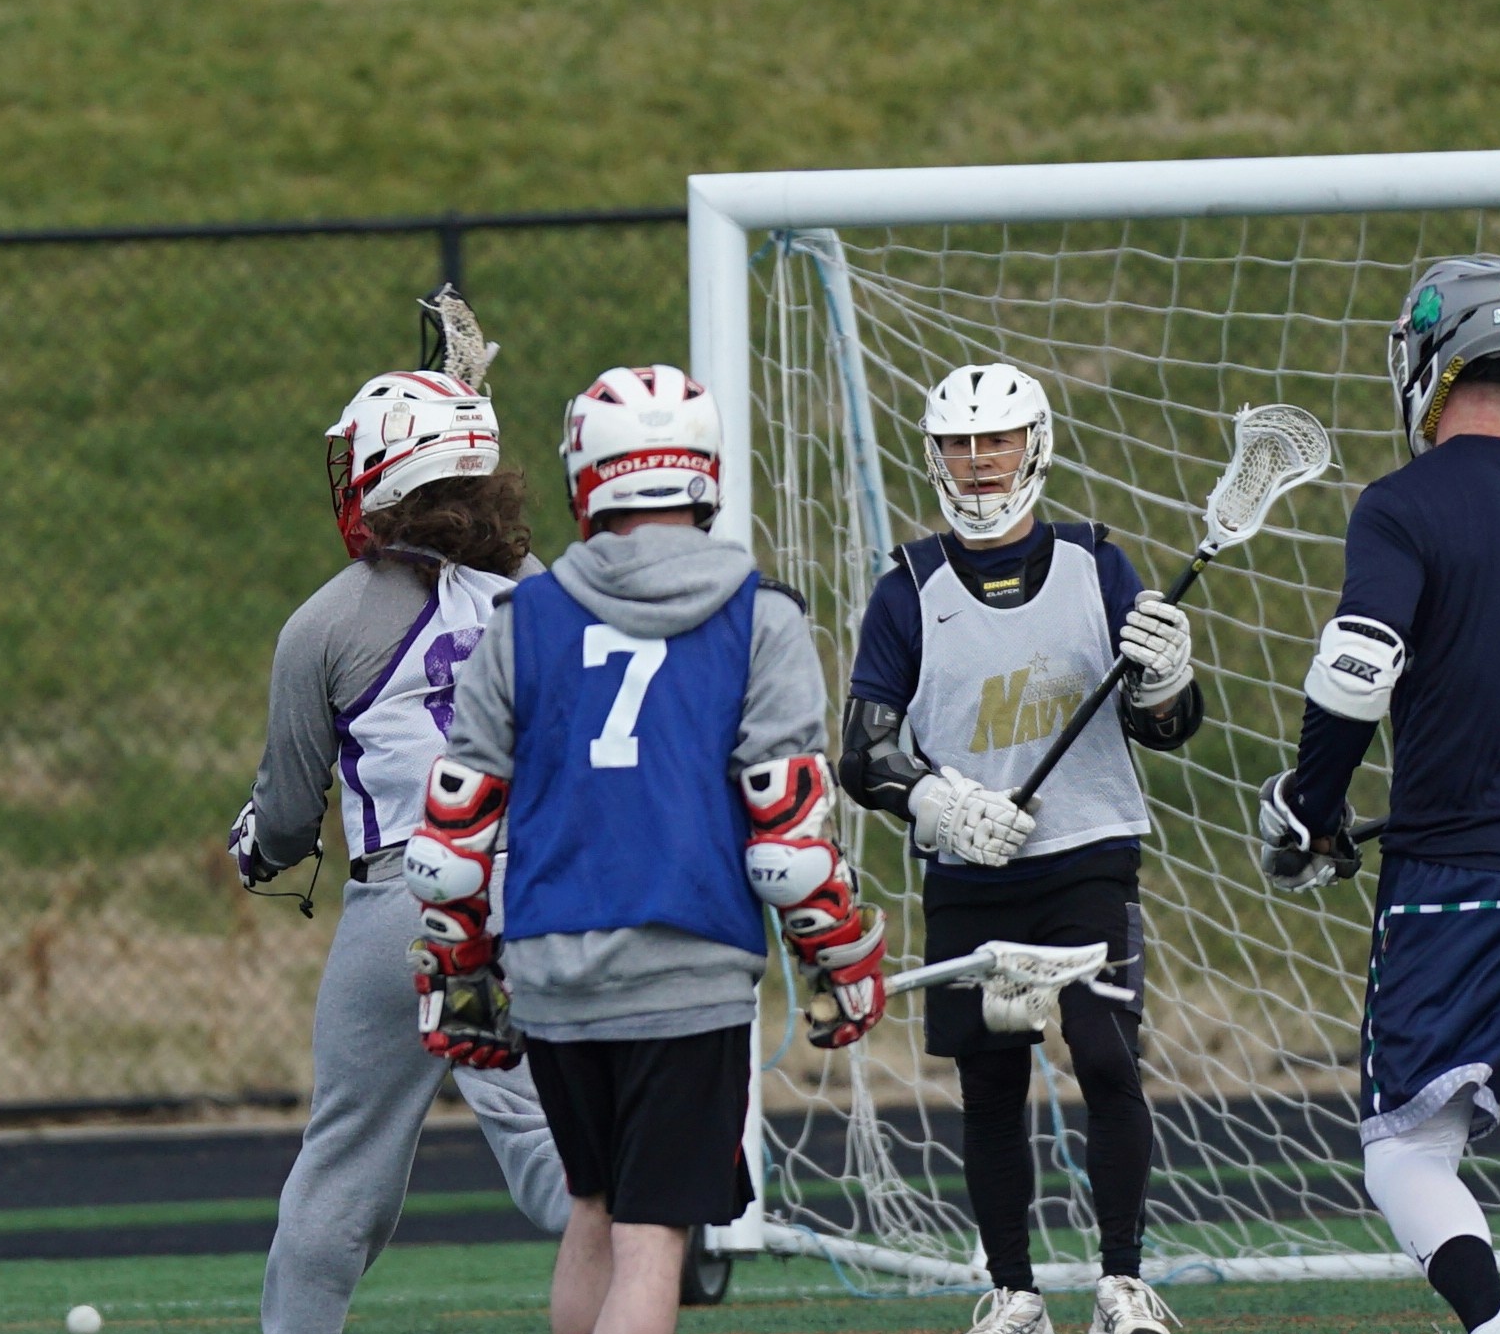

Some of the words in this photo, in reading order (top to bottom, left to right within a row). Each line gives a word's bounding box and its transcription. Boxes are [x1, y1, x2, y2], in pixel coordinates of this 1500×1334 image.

[456, 414, 483, 422] ENGLAND
[599, 454, 711, 481] WOLFPACK
[983, 577, 1020, 590] BRINE
[986, 588, 1020, 598] CLUTCH
[1334, 655, 1378, 682] STX
[582, 624, 667, 769] 7
[407, 856, 441, 880] STX
[751, 868, 788, 882] STX
